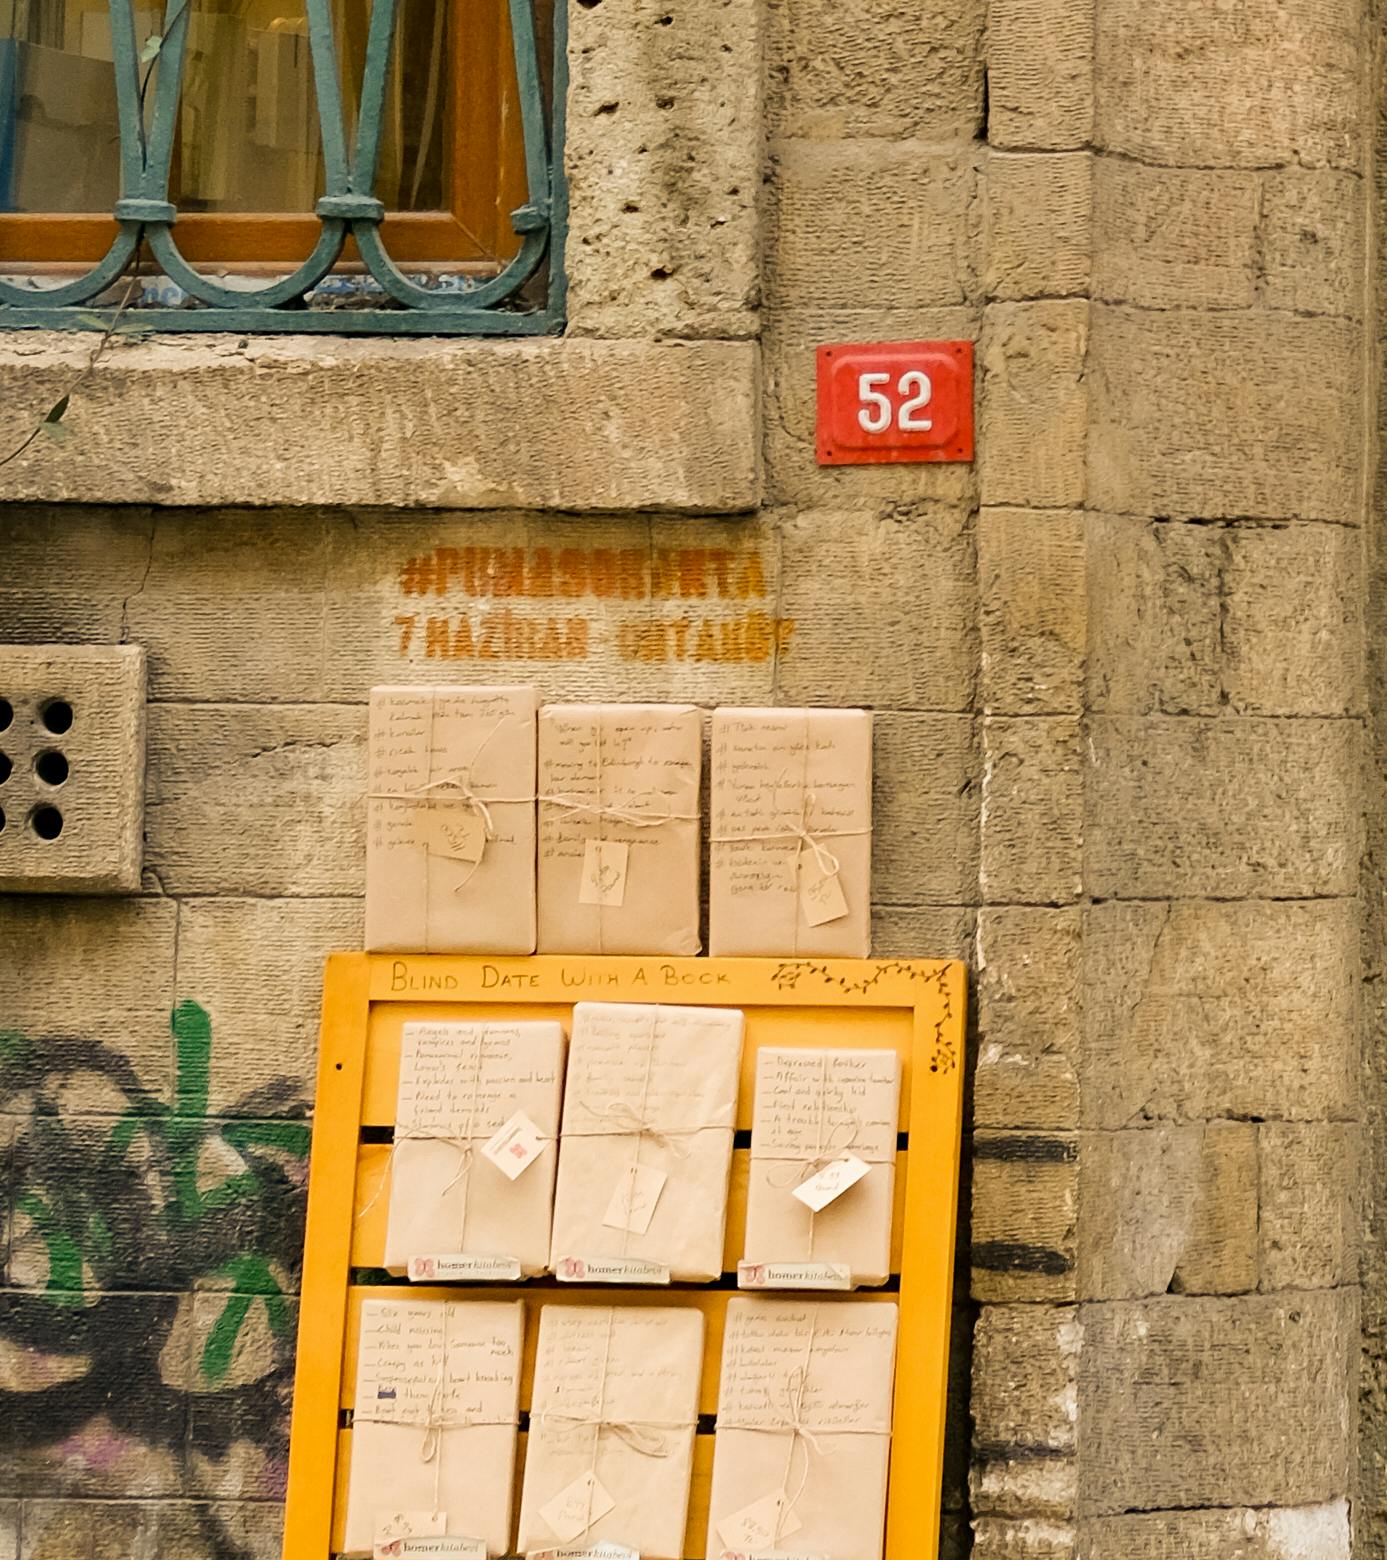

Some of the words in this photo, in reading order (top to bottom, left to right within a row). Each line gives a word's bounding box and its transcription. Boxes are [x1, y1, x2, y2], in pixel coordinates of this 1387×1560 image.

[856, 371, 934, 434] 52
[390, 961, 460, 992] BLIND
[481, 964, 540, 989] DATE
[632, 967, 649, 986] A
